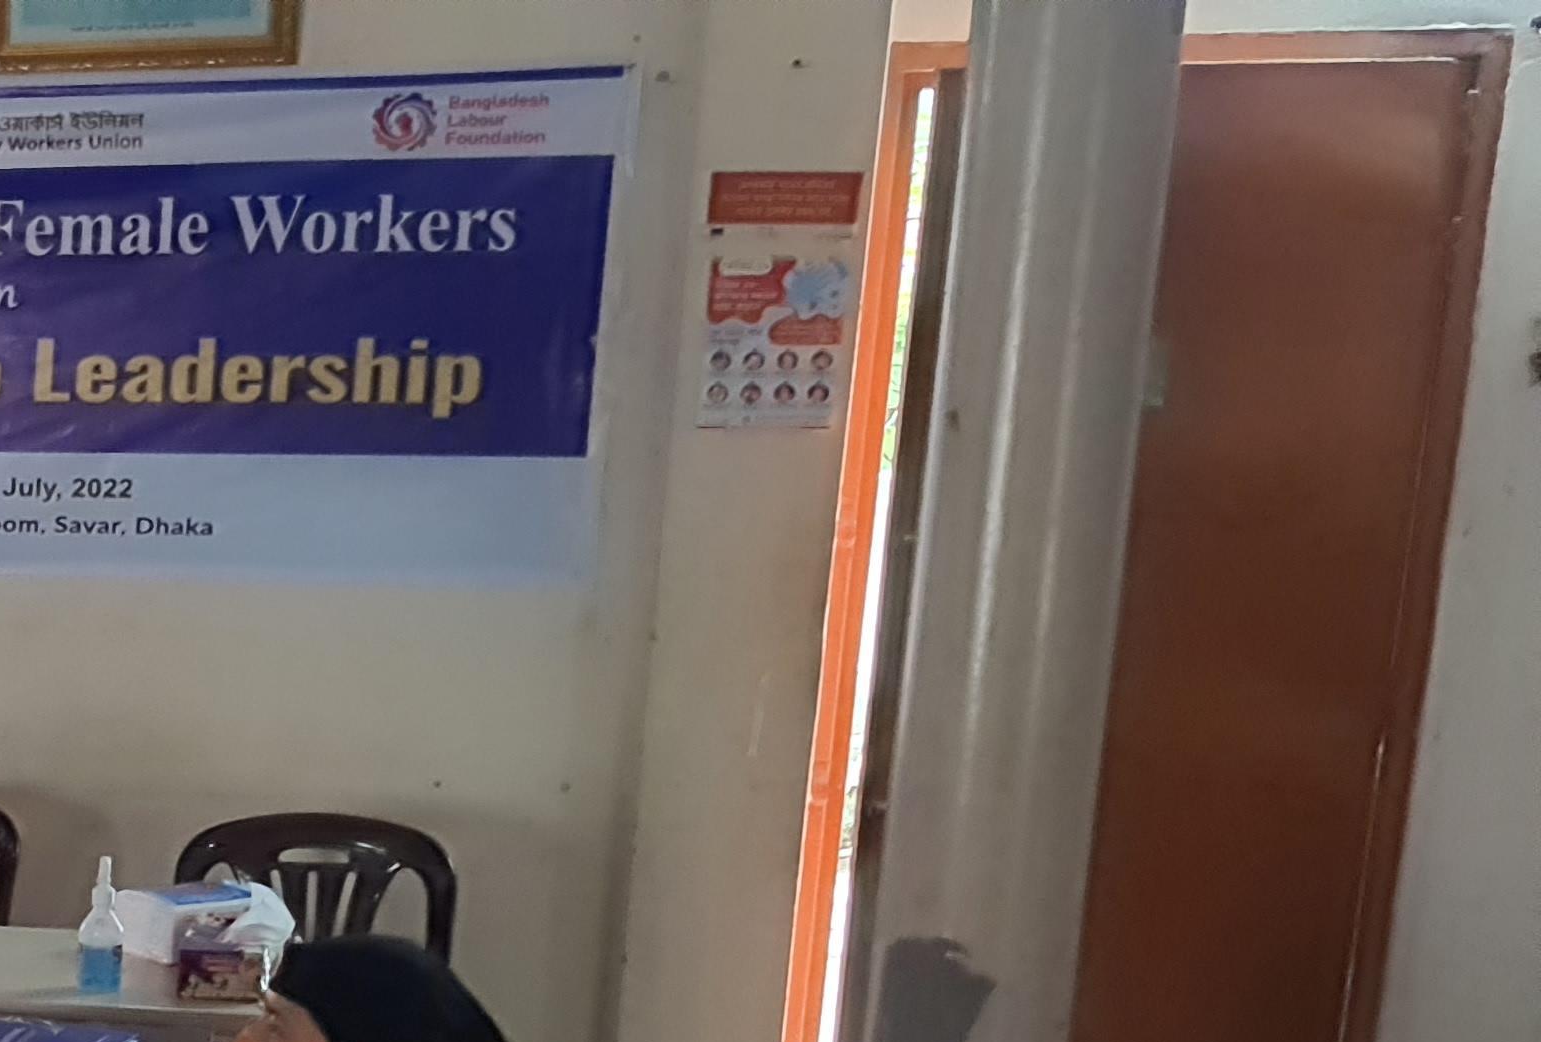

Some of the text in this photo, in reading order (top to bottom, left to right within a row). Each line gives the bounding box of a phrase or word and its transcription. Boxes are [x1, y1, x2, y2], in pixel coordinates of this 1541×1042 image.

[449, 93, 550, 111] Bangladesh
[447, 113, 508, 128] Labour
[7, 136, 83, 152] Workers
[89, 133, 143, 150] Union
[444, 130, 546, 146] Foundation
[230, 193, 518, 255] Workers
[33, 336, 483, 418] Leadership
[1, 476, 62, 503] July,
[70, 477, 134, 500] 2022
[54, 515, 127, 537] Savar,
[136, 517, 214, 537] Dhaka
